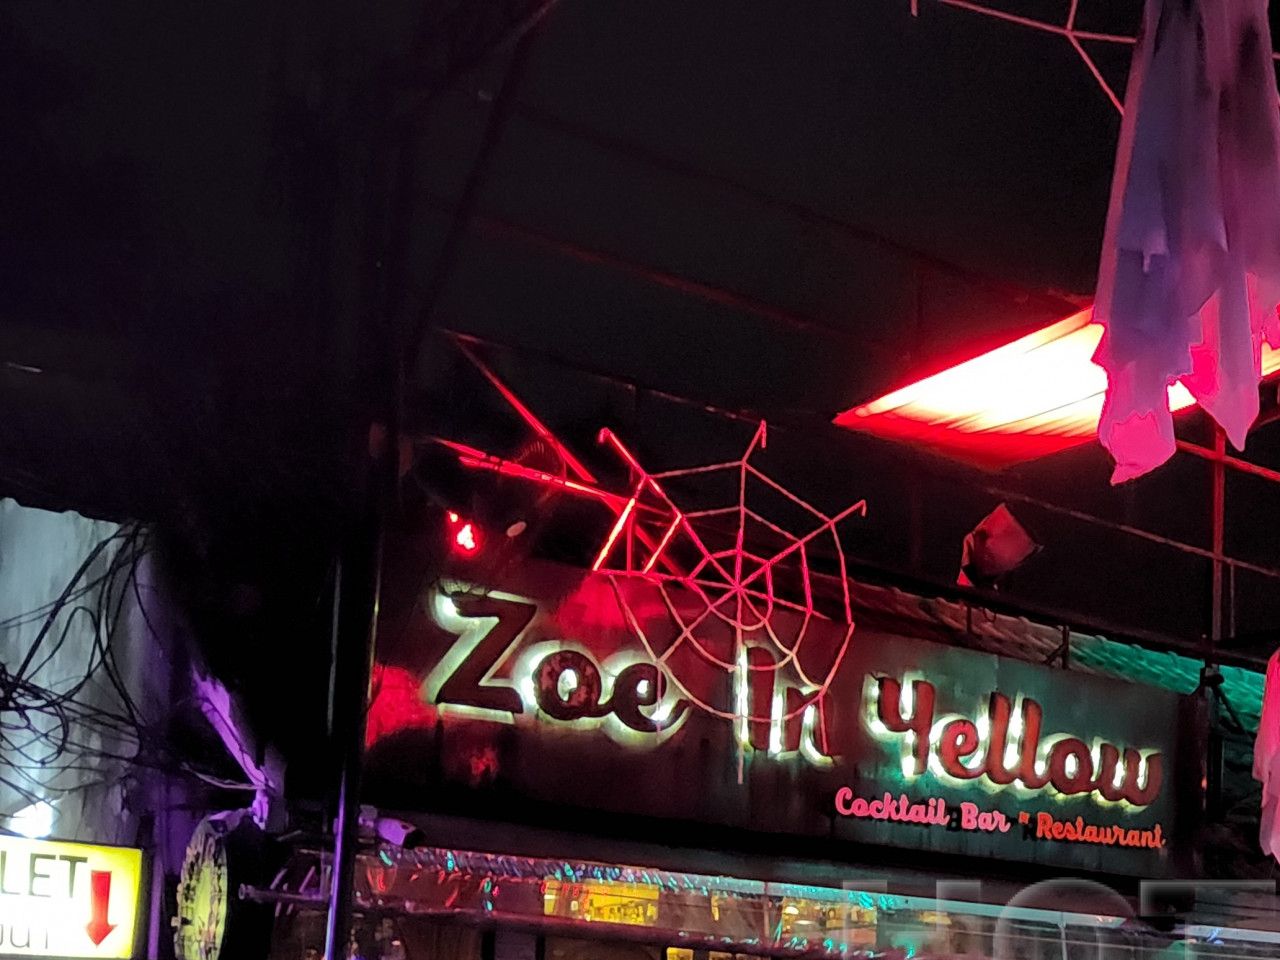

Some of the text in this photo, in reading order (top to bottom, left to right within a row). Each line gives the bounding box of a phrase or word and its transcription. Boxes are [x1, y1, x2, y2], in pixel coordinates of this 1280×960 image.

[434, 583, 691, 738] Zoe
[868, 672, 1162, 808] Yellow
[834, 786, 1167, 849] Cocktail Bar Restaurant
